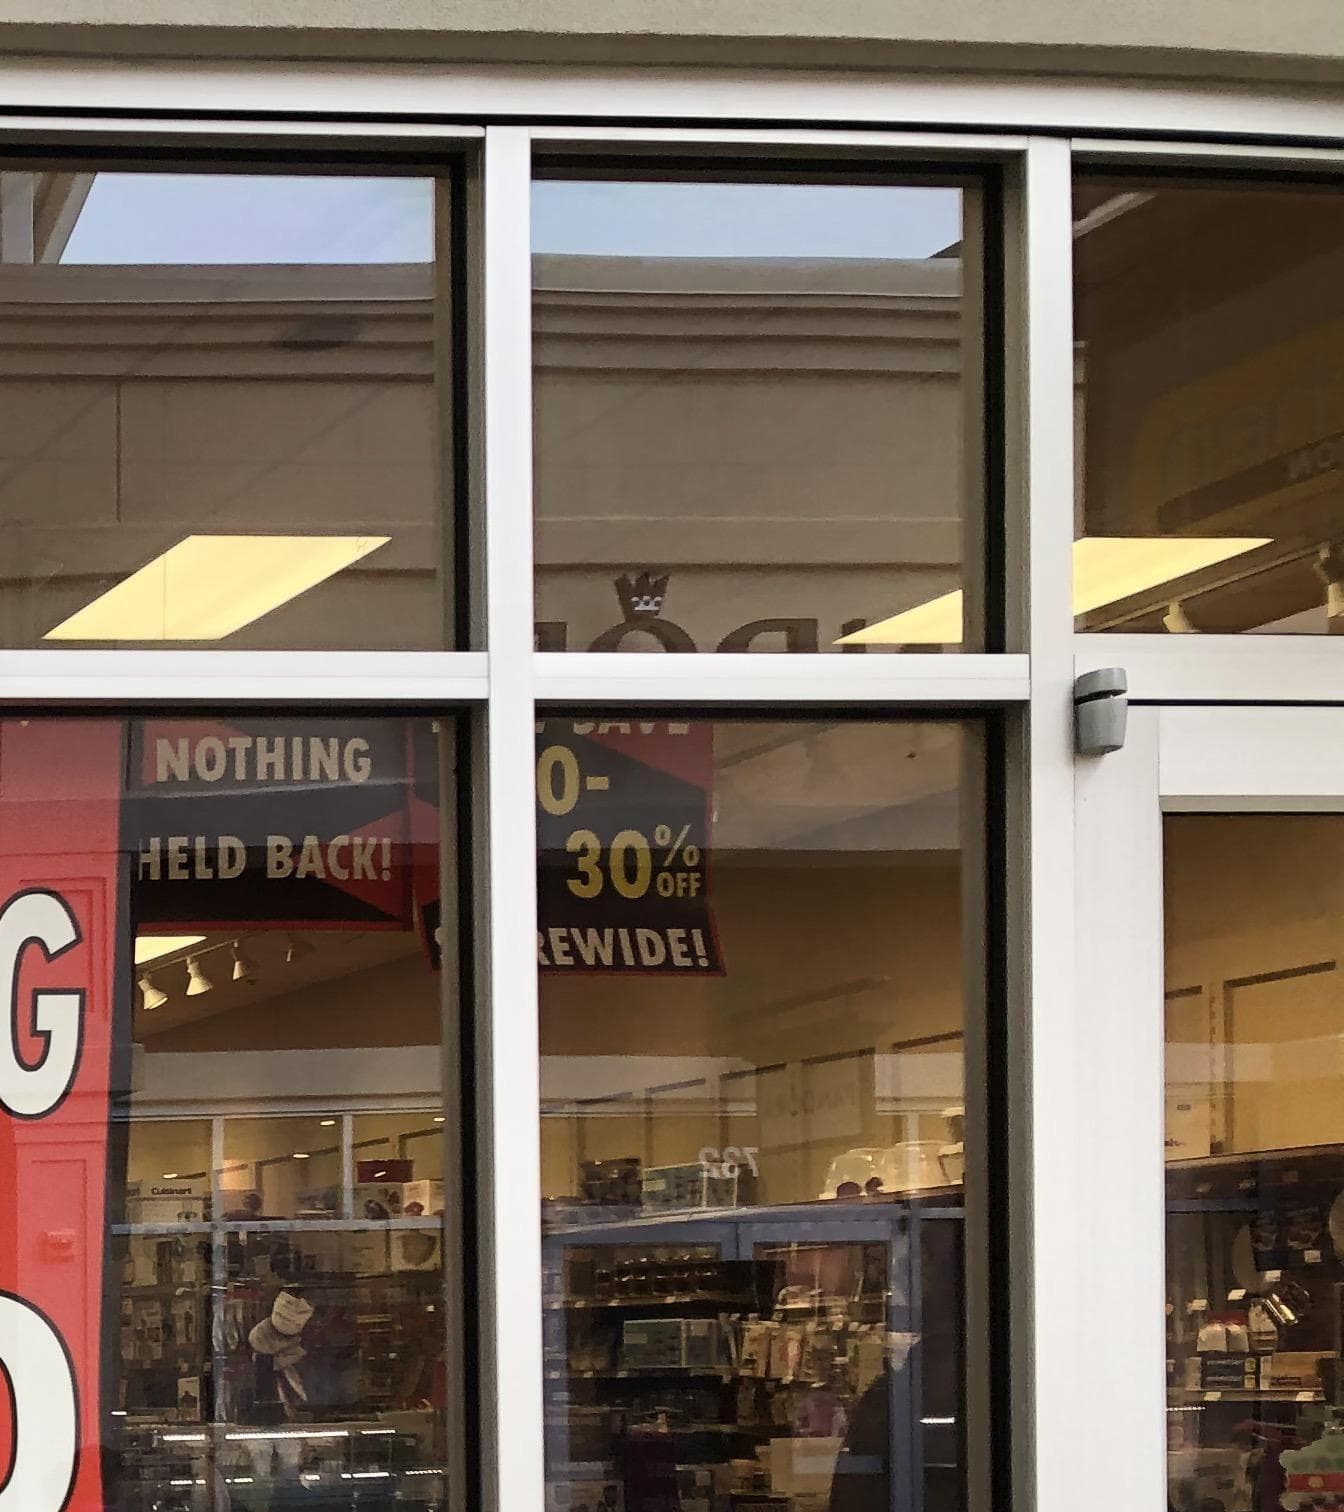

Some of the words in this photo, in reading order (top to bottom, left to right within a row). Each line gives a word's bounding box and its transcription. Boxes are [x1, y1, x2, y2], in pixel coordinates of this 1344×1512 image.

[155, 735, 372, 783] NOTHING
[137, 835, 248, 882] HELD
[266, 835, 392, 882] BACK!
[655, 871, 702, 898] OFF
